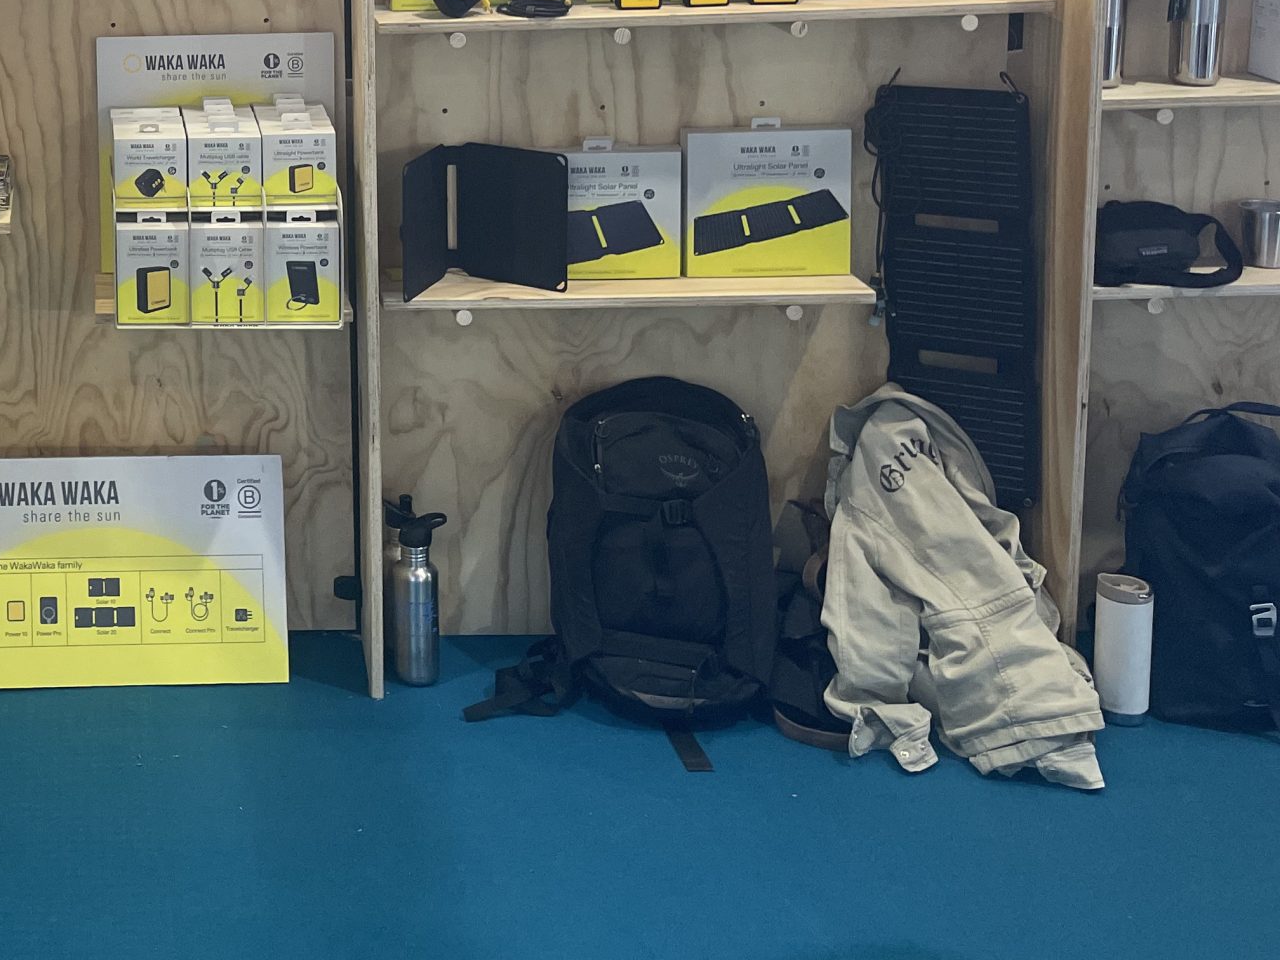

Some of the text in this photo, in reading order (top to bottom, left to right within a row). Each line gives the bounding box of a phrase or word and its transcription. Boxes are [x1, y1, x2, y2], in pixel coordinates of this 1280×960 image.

[145, 54, 226, 70] WAKA WAKA
[161, 73, 187, 81] share
[733, 163, 766, 171] Ultralight
[568, 183, 596, 191] ltralight
[61, 480, 119, 505] WAKA
[23, 510, 120, 524] share the sun
[10, 561, 55, 570] WakaWaka
[57, 560, 83, 572] family
